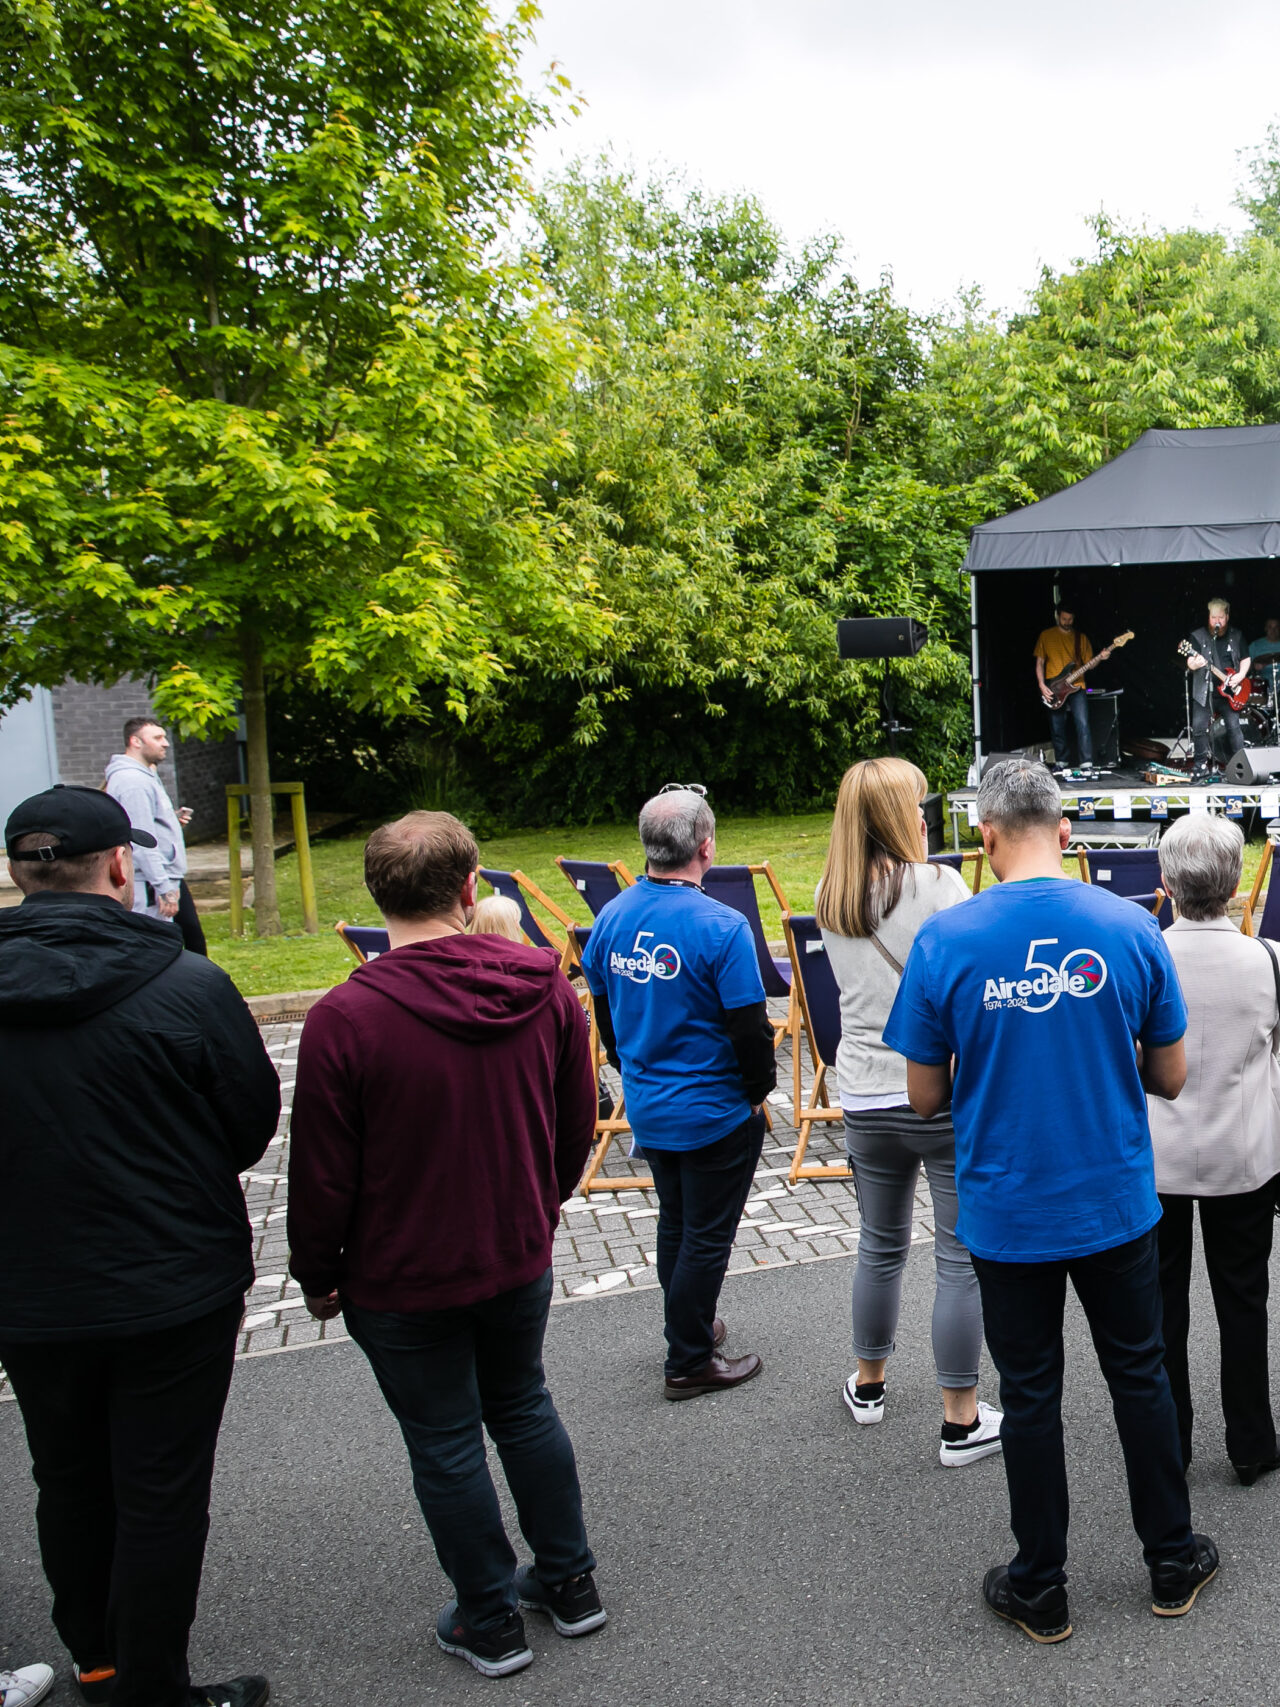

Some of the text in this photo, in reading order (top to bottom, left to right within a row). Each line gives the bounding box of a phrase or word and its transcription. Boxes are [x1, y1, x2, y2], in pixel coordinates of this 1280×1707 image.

[1080, 800, 1094, 812] 50
[1151, 799, 1167, 811] 50
[1227, 798, 1242, 810] 50
[610, 952, 667, 975] Airedale
[632, 930, 681, 984] 50
[983, 970, 1085, 1002] Airedale
[1020, 938, 1108, 1013] 50
